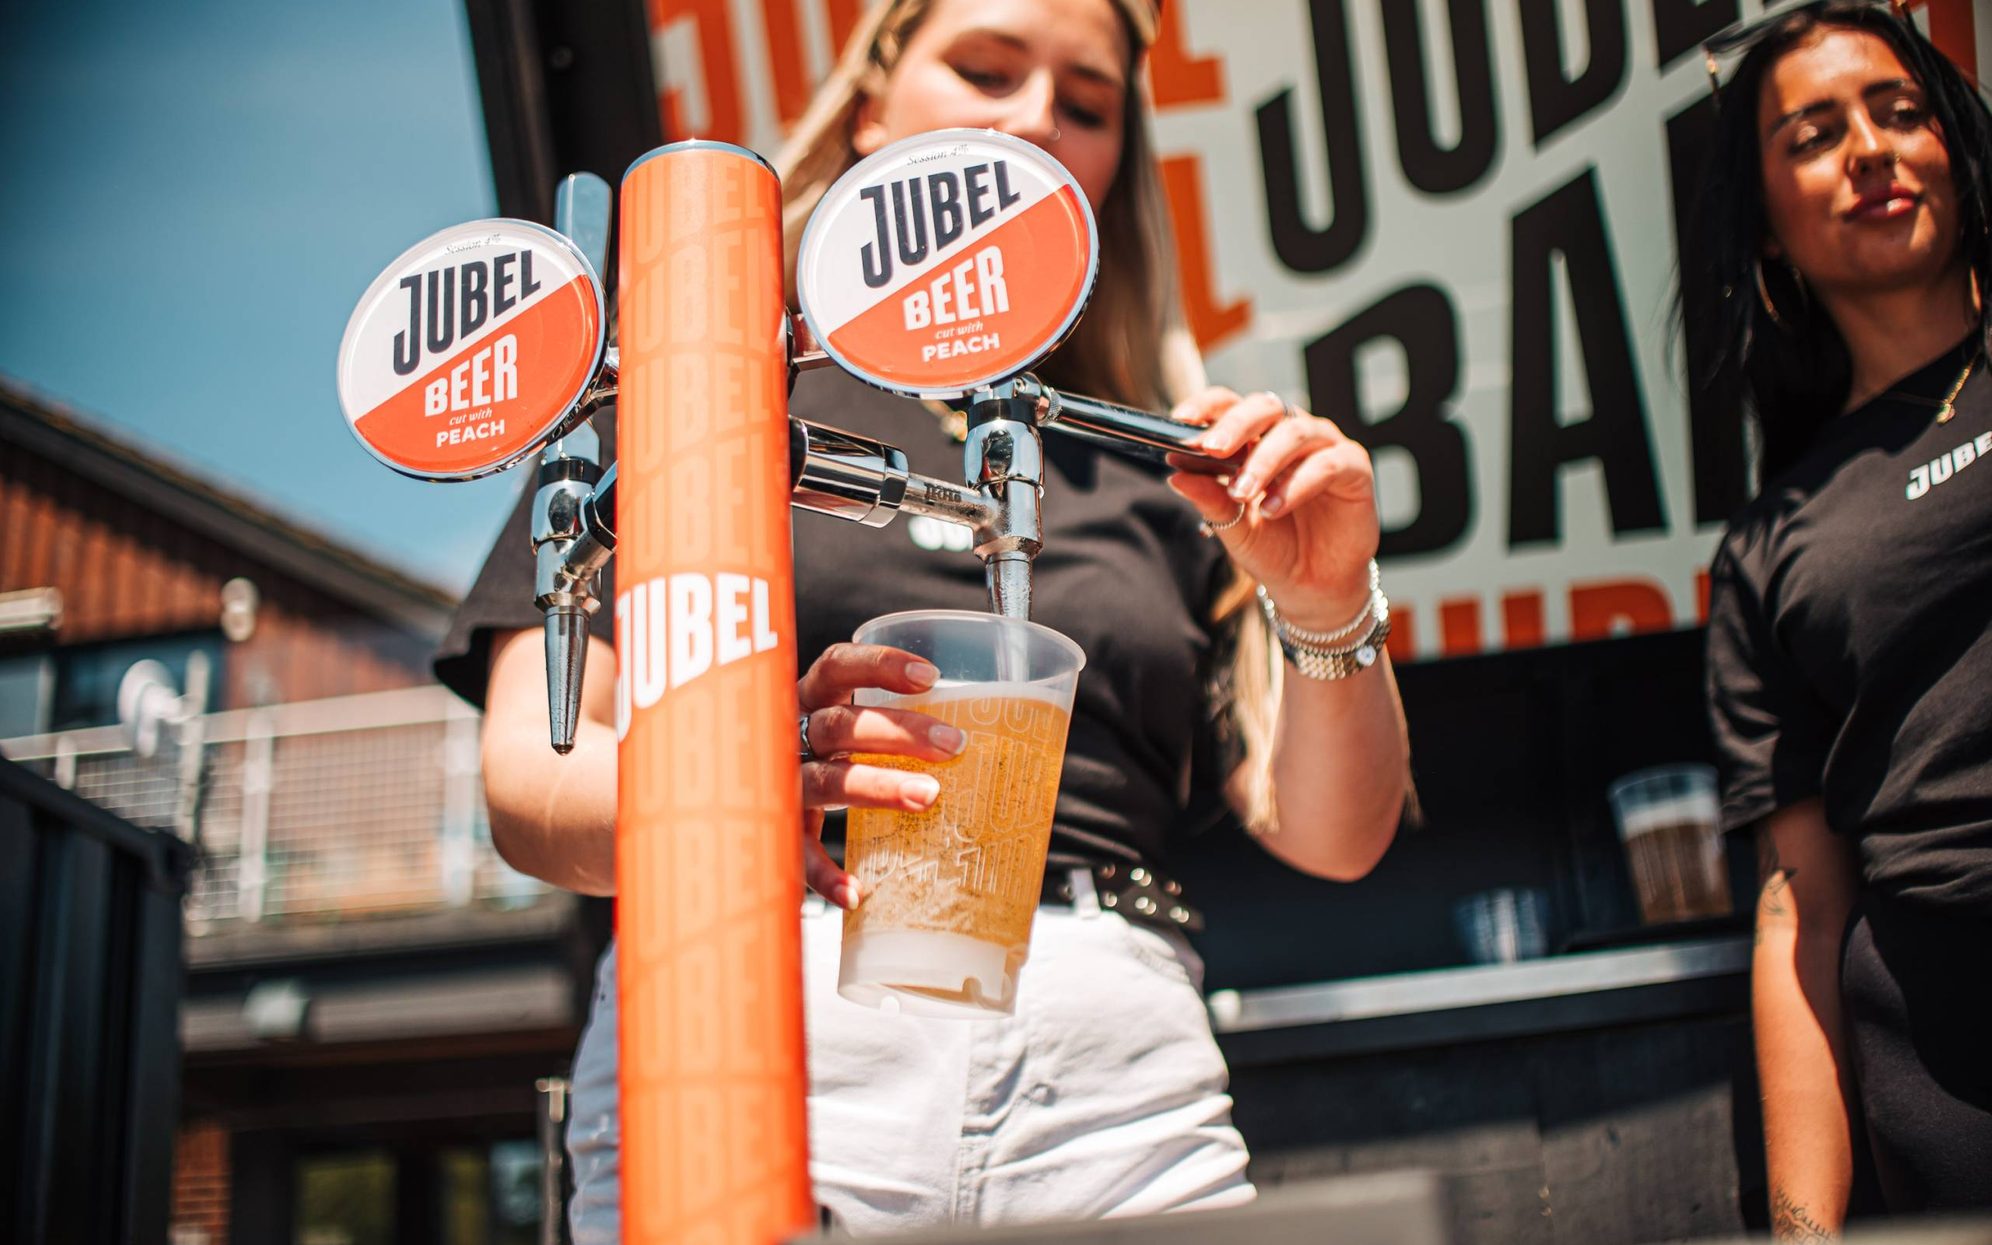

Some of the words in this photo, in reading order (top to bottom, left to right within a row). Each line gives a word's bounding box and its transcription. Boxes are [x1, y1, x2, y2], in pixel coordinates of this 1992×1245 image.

[860, 160, 1022, 289] JUBEL
[393, 249, 542, 377] JUBEL
[903, 246, 1010, 331] BEER
[922, 332, 1001, 363] PEACH
[935, 327, 957, 341] cut
[957, 320, 984, 336] with
[424, 333, 518, 418] BEER
[436, 418, 506, 449] PEACH
[449, 412, 467, 427] cut
[469, 407, 493, 422] with
[1905, 430, 1992, 502] JUBE
